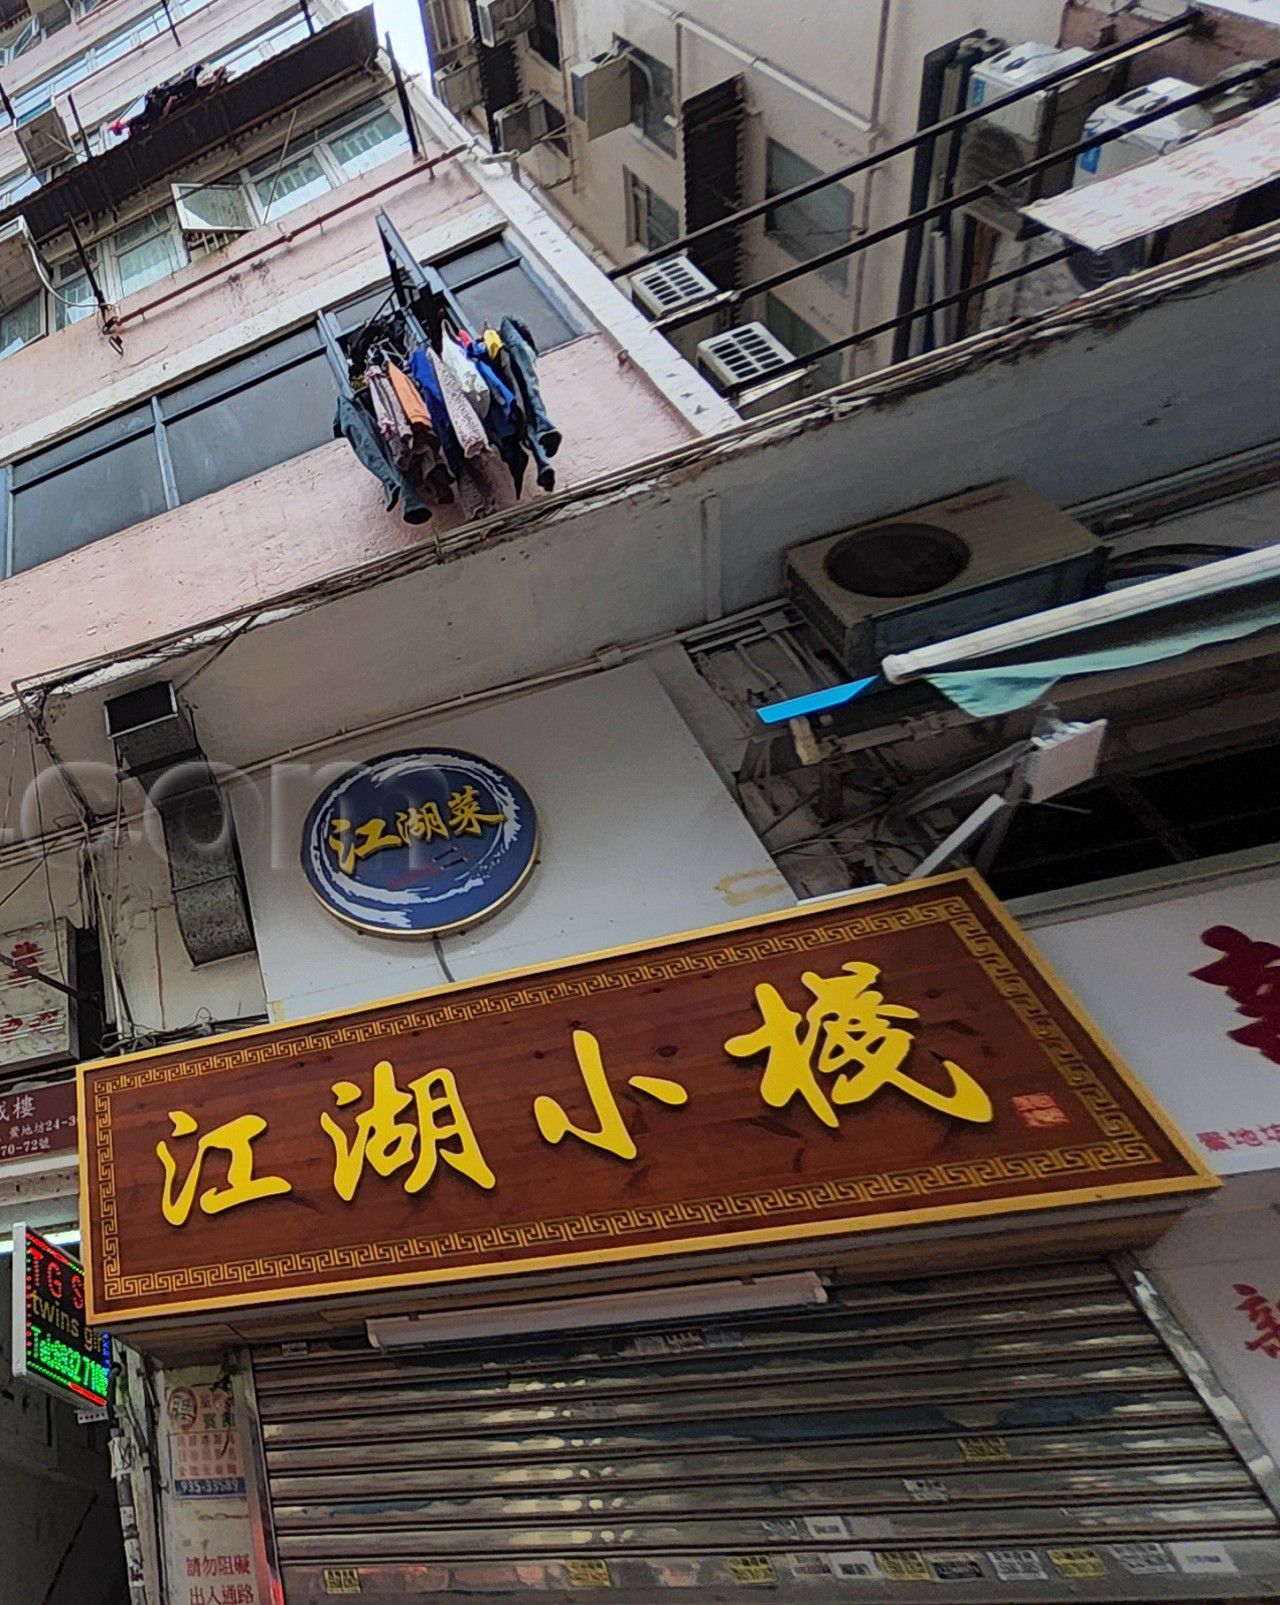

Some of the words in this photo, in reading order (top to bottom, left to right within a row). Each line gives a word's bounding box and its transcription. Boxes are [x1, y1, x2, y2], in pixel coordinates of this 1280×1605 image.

[329, 784, 506, 874] 江湖菜
[156, 961, 994, 1226] 江湖小棧
[186, 1553, 251, 1577] 請勿阻礙
